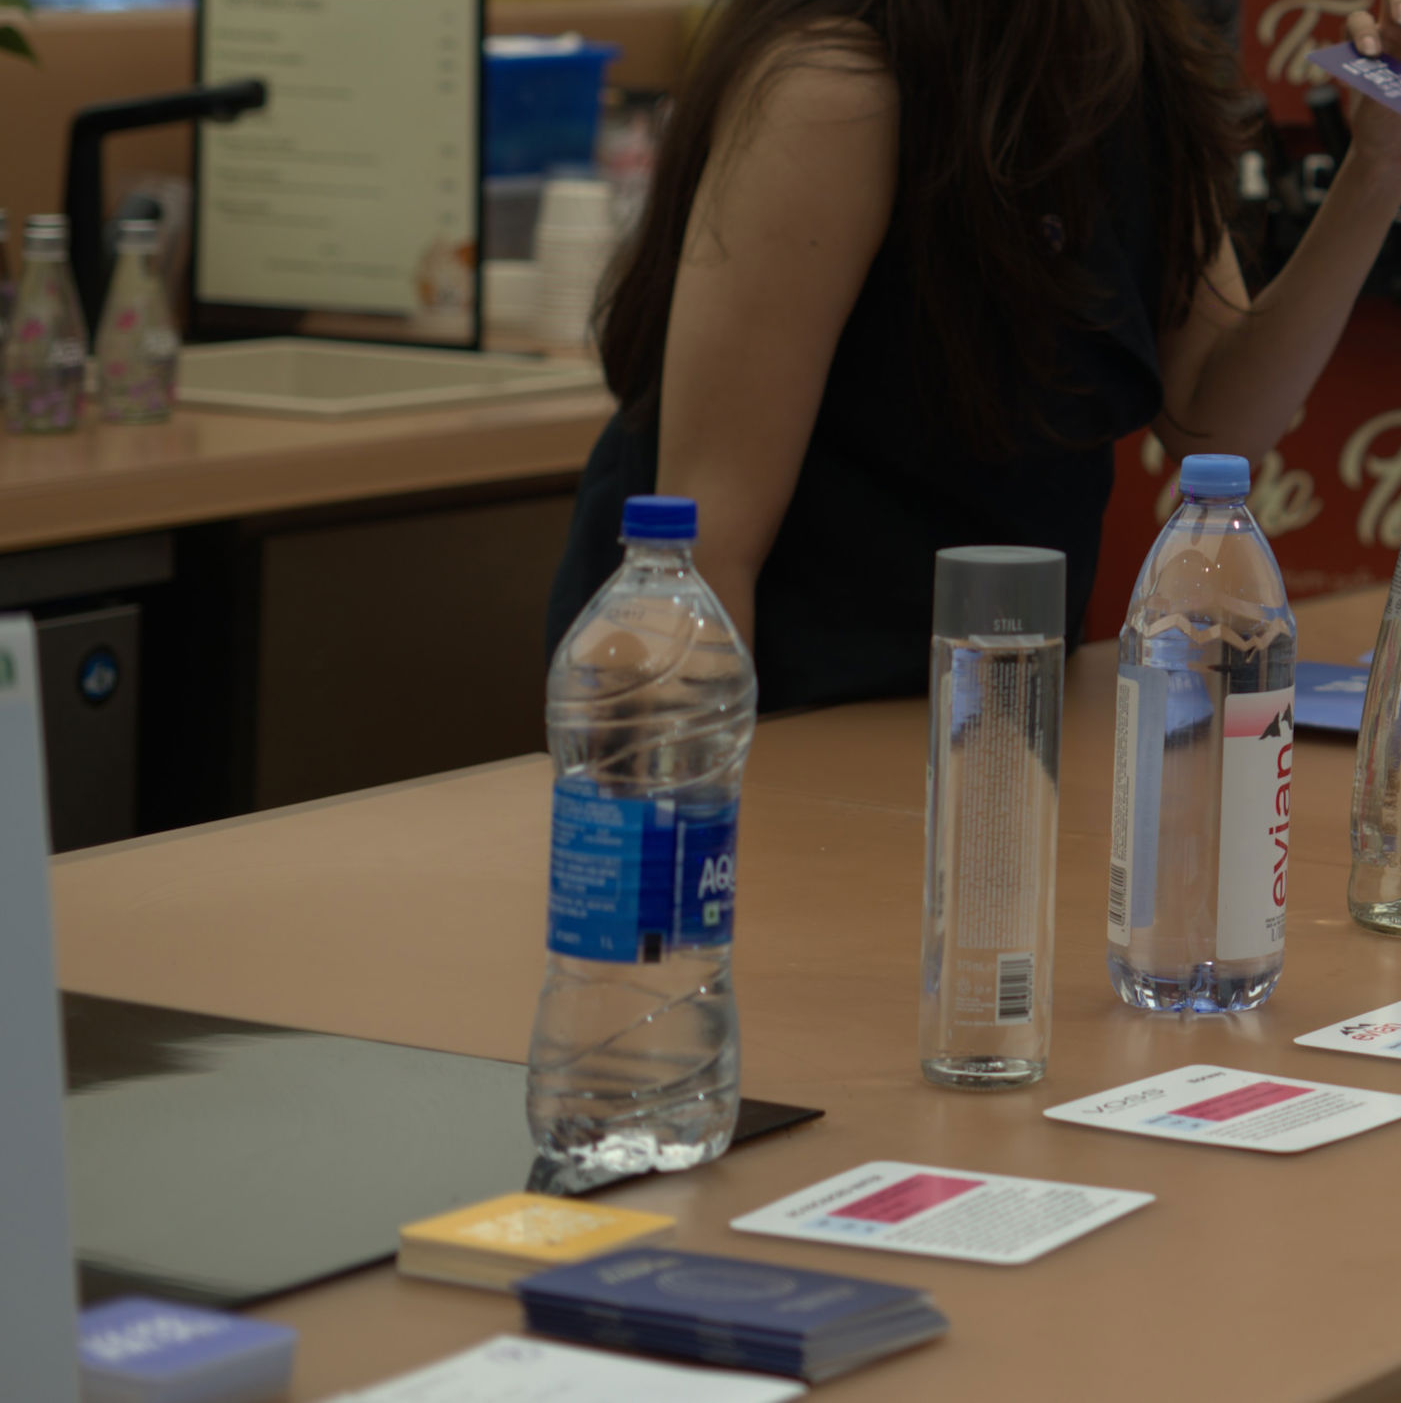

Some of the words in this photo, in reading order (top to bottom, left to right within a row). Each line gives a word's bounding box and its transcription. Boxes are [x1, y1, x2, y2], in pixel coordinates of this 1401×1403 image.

[993, 618, 1024, 632] STILL
[1268, 741, 1294, 908] evian
[1082, 1087, 1165, 1114] VOSS
